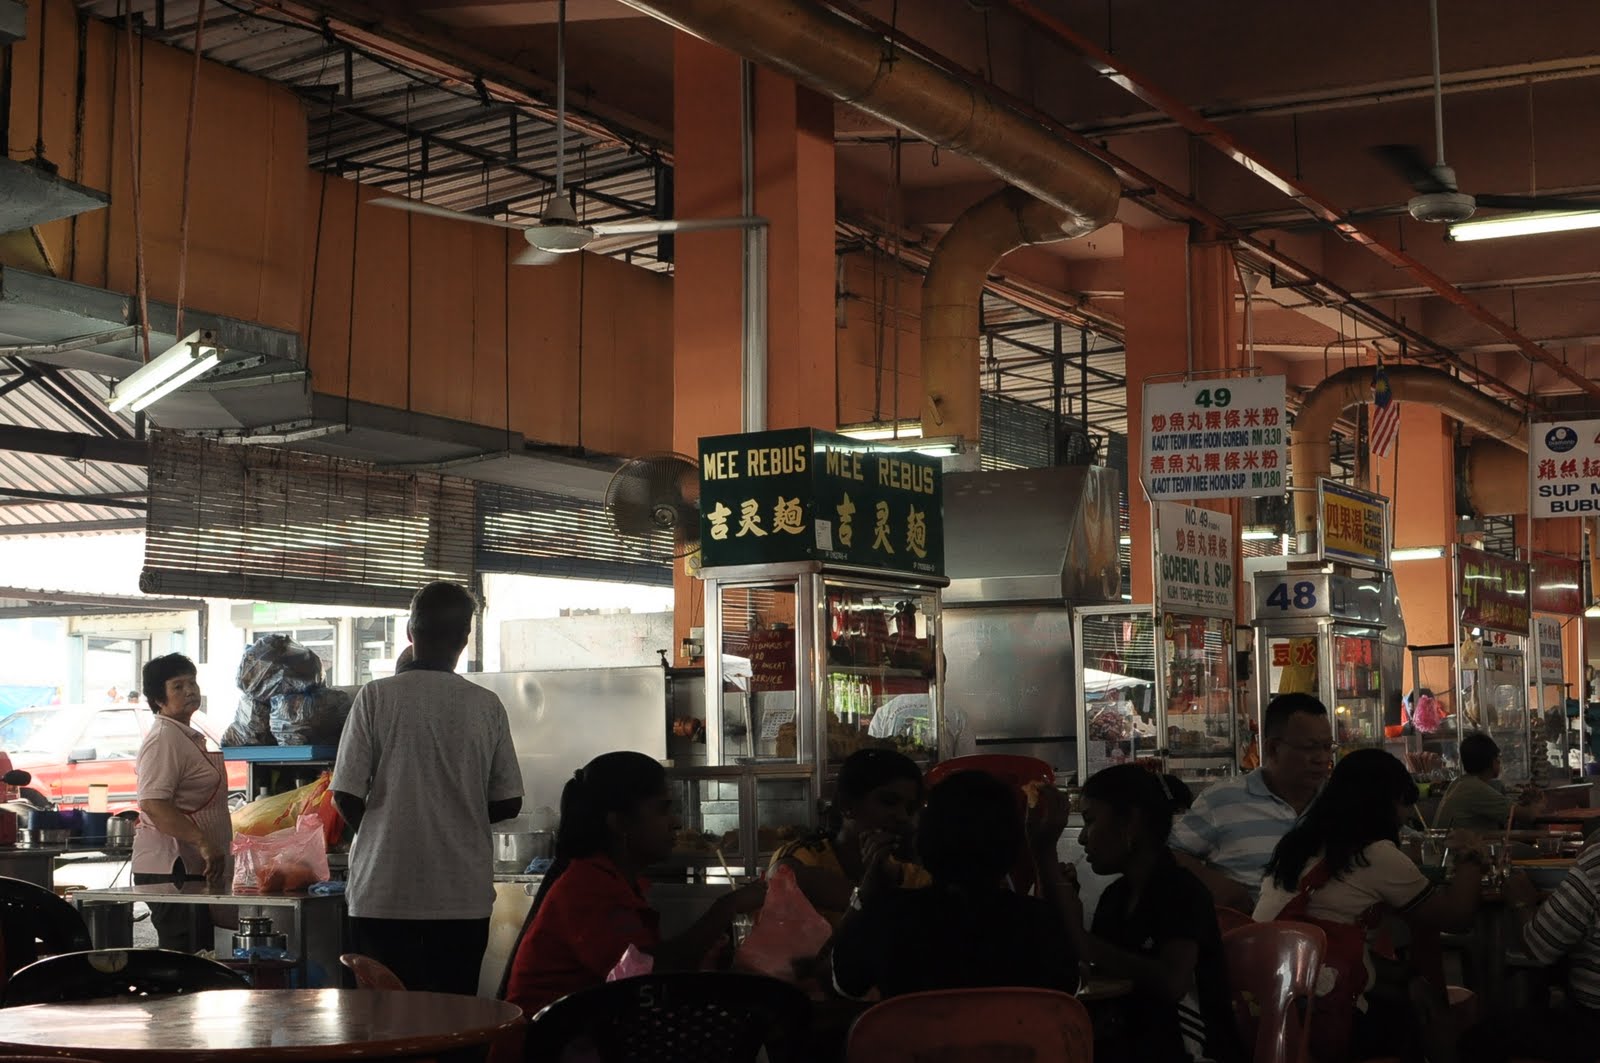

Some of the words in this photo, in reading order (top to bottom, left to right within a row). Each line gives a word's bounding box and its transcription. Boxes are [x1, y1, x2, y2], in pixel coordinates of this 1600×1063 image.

[1194, 387, 1232, 408] 49
[1151, 407, 1279, 433] 炒魚丸粿條米粉
[1170, 434, 1188, 450] TEOW
[1188, 433, 1202, 449] MEE
[1203, 431, 1221, 448] HOON
[1222, 431, 1249, 447] GORENG
[1252, 430, 1263, 446] RM
[1264, 428, 1282, 445] 3.30
[703, 450, 739, 481] MEE
[747, 444, 807, 477] REBUS
[825, 446, 865, 481] MEE
[878, 457, 935, 495] REBUS
[1150, 449, 1279, 475] 煮魚丸粿條米粉
[1171, 476, 1191, 493] TEOW
[1192, 475, 1207, 492] MEE
[1209, 474, 1231, 491] HOON
[1232, 473, 1246, 490] SUP
[1252, 472, 1263, 488] RM
[1538, 484, 1580, 498] SUP
[1199, 511, 1208, 527] 49
[1363, 507, 1382, 524] LENG
[1363, 522, 1382, 538] CHEE
[1162, 554, 1200, 585] GORENG
[1203, 561, 1210, 586] &
[1214, 562, 1232, 589] SUP
[1266, 581, 1317, 611] 48
[1272, 642, 1317, 668] 豆水
